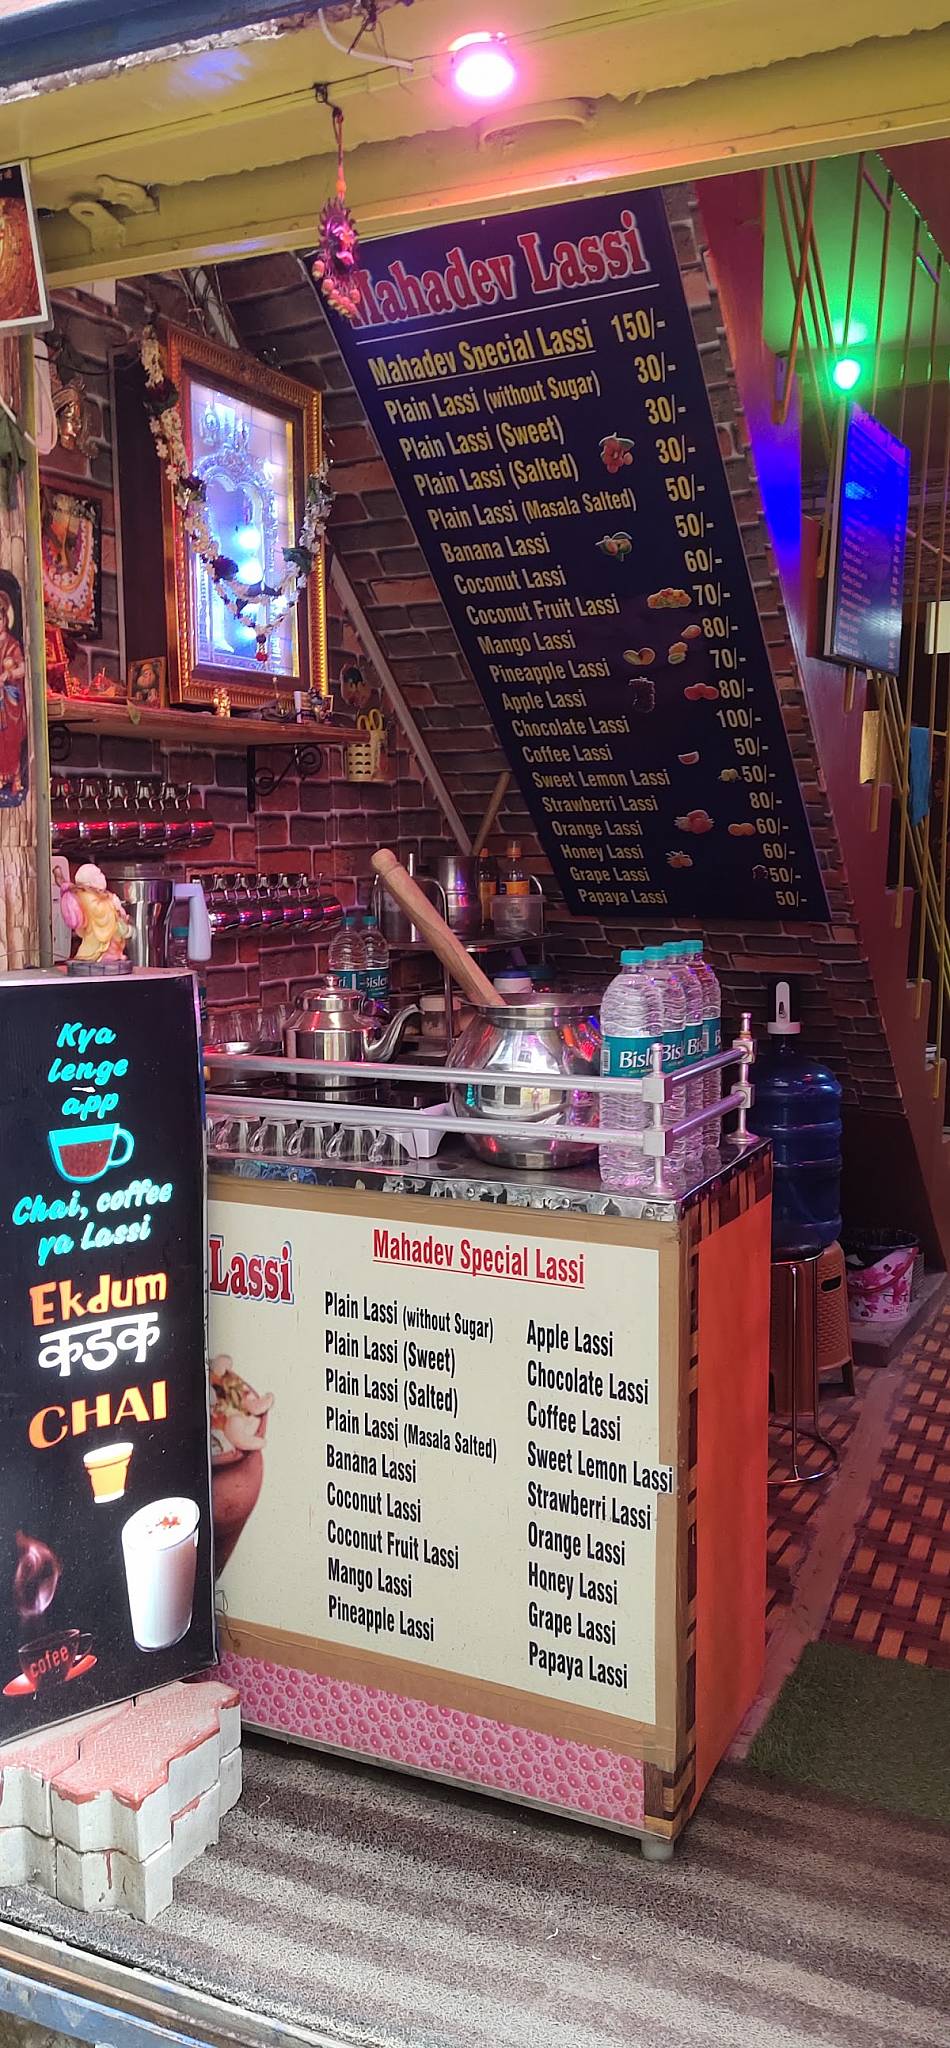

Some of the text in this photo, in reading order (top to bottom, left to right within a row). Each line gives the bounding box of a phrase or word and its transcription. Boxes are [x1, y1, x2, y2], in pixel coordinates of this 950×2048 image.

[517, 209, 650, 294] Lassi
[368, 307, 666, 386] Mahadev Special Lassi 150/-
[384, 351, 676, 424] Plain Lassi (without Sugar) 30/-
[399, 394, 687, 461] Plain Lassi (Sweet) 30/-
[413, 434, 696, 497] Plain Lassi (Salted) 30/-
[427, 473, 705, 531] Plain Lassi (Masala Salted) 50/-
[440, 511, 714, 563] Banana Lassi 50/-
[453, 548, 723, 595] Coconut Lassi 60/-
[465, 582, 731, 626] Coconut Fruit Lassi 70/-
[477, 616, 738, 656] Mango Lassi 80/-
[489, 647, 746, 684] Pineapple Lassi 70/-
[501, 678, 754, 714] Apple Lassi 80/-
[511, 707, 762, 737] Chocolate Lassi 100/-
[521, 736, 769, 764] Coffee Lassi 50/-
[532, 764, 776, 789] Sweet Lemon Lassi 50/-
[541, 792, 783, 814] Strawberri Lassi 80/-
[552, 817, 789, 839] Orange Lassi 60/-
[560, 843, 795, 862] Honey Lassi 60/-
[570, 866, 801, 884] Grape Lassi 50/-
[578, 888, 807, 907] Papaya Lassi 50/-
[56, 1022, 116, 1053] Kya
[61, 1092, 119, 1121] app
[12, 1179, 173, 1225] Chai, coffee
[37, 1214, 151, 1266] ya Lassi
[373, 1228, 585, 1284] Mahadev Special Lassi
[209, 1234, 295, 1304] Lassi
[29, 1272, 167, 1326] Ekdum
[325, 1290, 494, 1344] Plain Lassi (without Sugar)
[38, 1311, 160, 1377] कडक
[325, 1329, 455, 1378] Plain Lassi (Sweet)
[527, 1319, 614, 1357] Apple Lassi
[325, 1367, 458, 1419] Plain Lassi (Salted)
[527, 1359, 649, 1405] Chocolate Lassi
[28, 1380, 167, 1449] CHAI
[326, 1406, 497, 1464] Plain Lassi (Masala Salted)
[527, 1400, 621, 1442] Coffee Lassi
[326, 1444, 416, 1484] Banana Lassi
[527, 1441, 674, 1494] Sweet Lemon Lassi
[327, 1481, 421, 1523] Coconut Lassi
[527, 1480, 651, 1531] Strawberri Lassi
[327, 1519, 459, 1570] Coconut Fruit Lassi
[528, 1521, 625, 1567] Orange Lassi
[328, 1557, 412, 1599] Mango Lassi
[528, 1561, 618, 1606] Honey Lassi
[328, 1594, 435, 1642] Pineapple Lassi
[528, 1601, 616, 1646] Grape Lassi
[29, 1644, 71, 1679] cofee
[529, 1641, 628, 1689] Papaya Lassi
